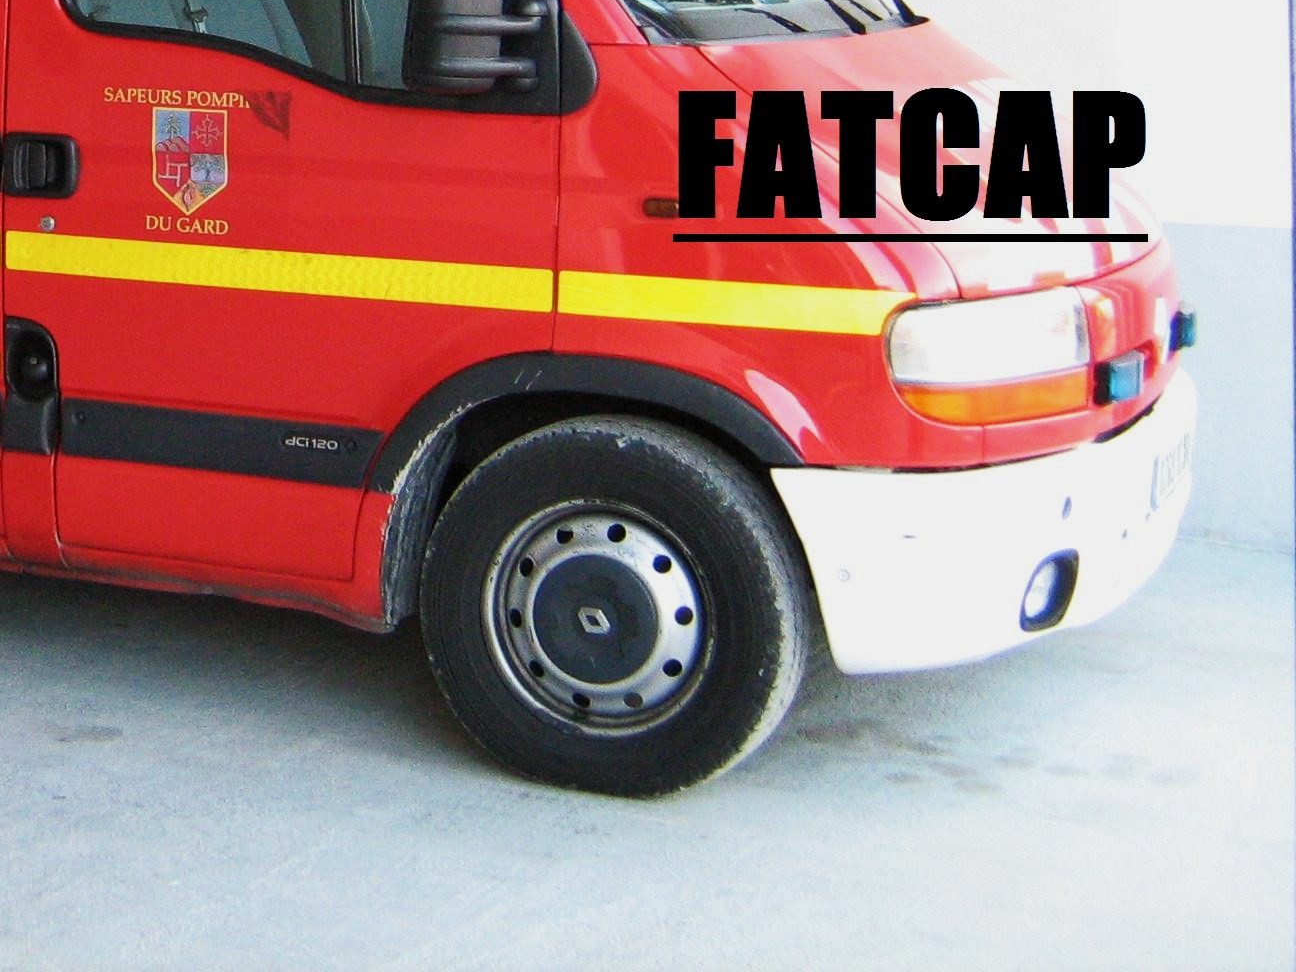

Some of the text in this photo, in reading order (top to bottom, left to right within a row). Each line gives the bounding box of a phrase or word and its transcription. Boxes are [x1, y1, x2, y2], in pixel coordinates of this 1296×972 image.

[104, 87, 182, 105] SAPEURS
[145, 215, 229, 235] DU GARD
